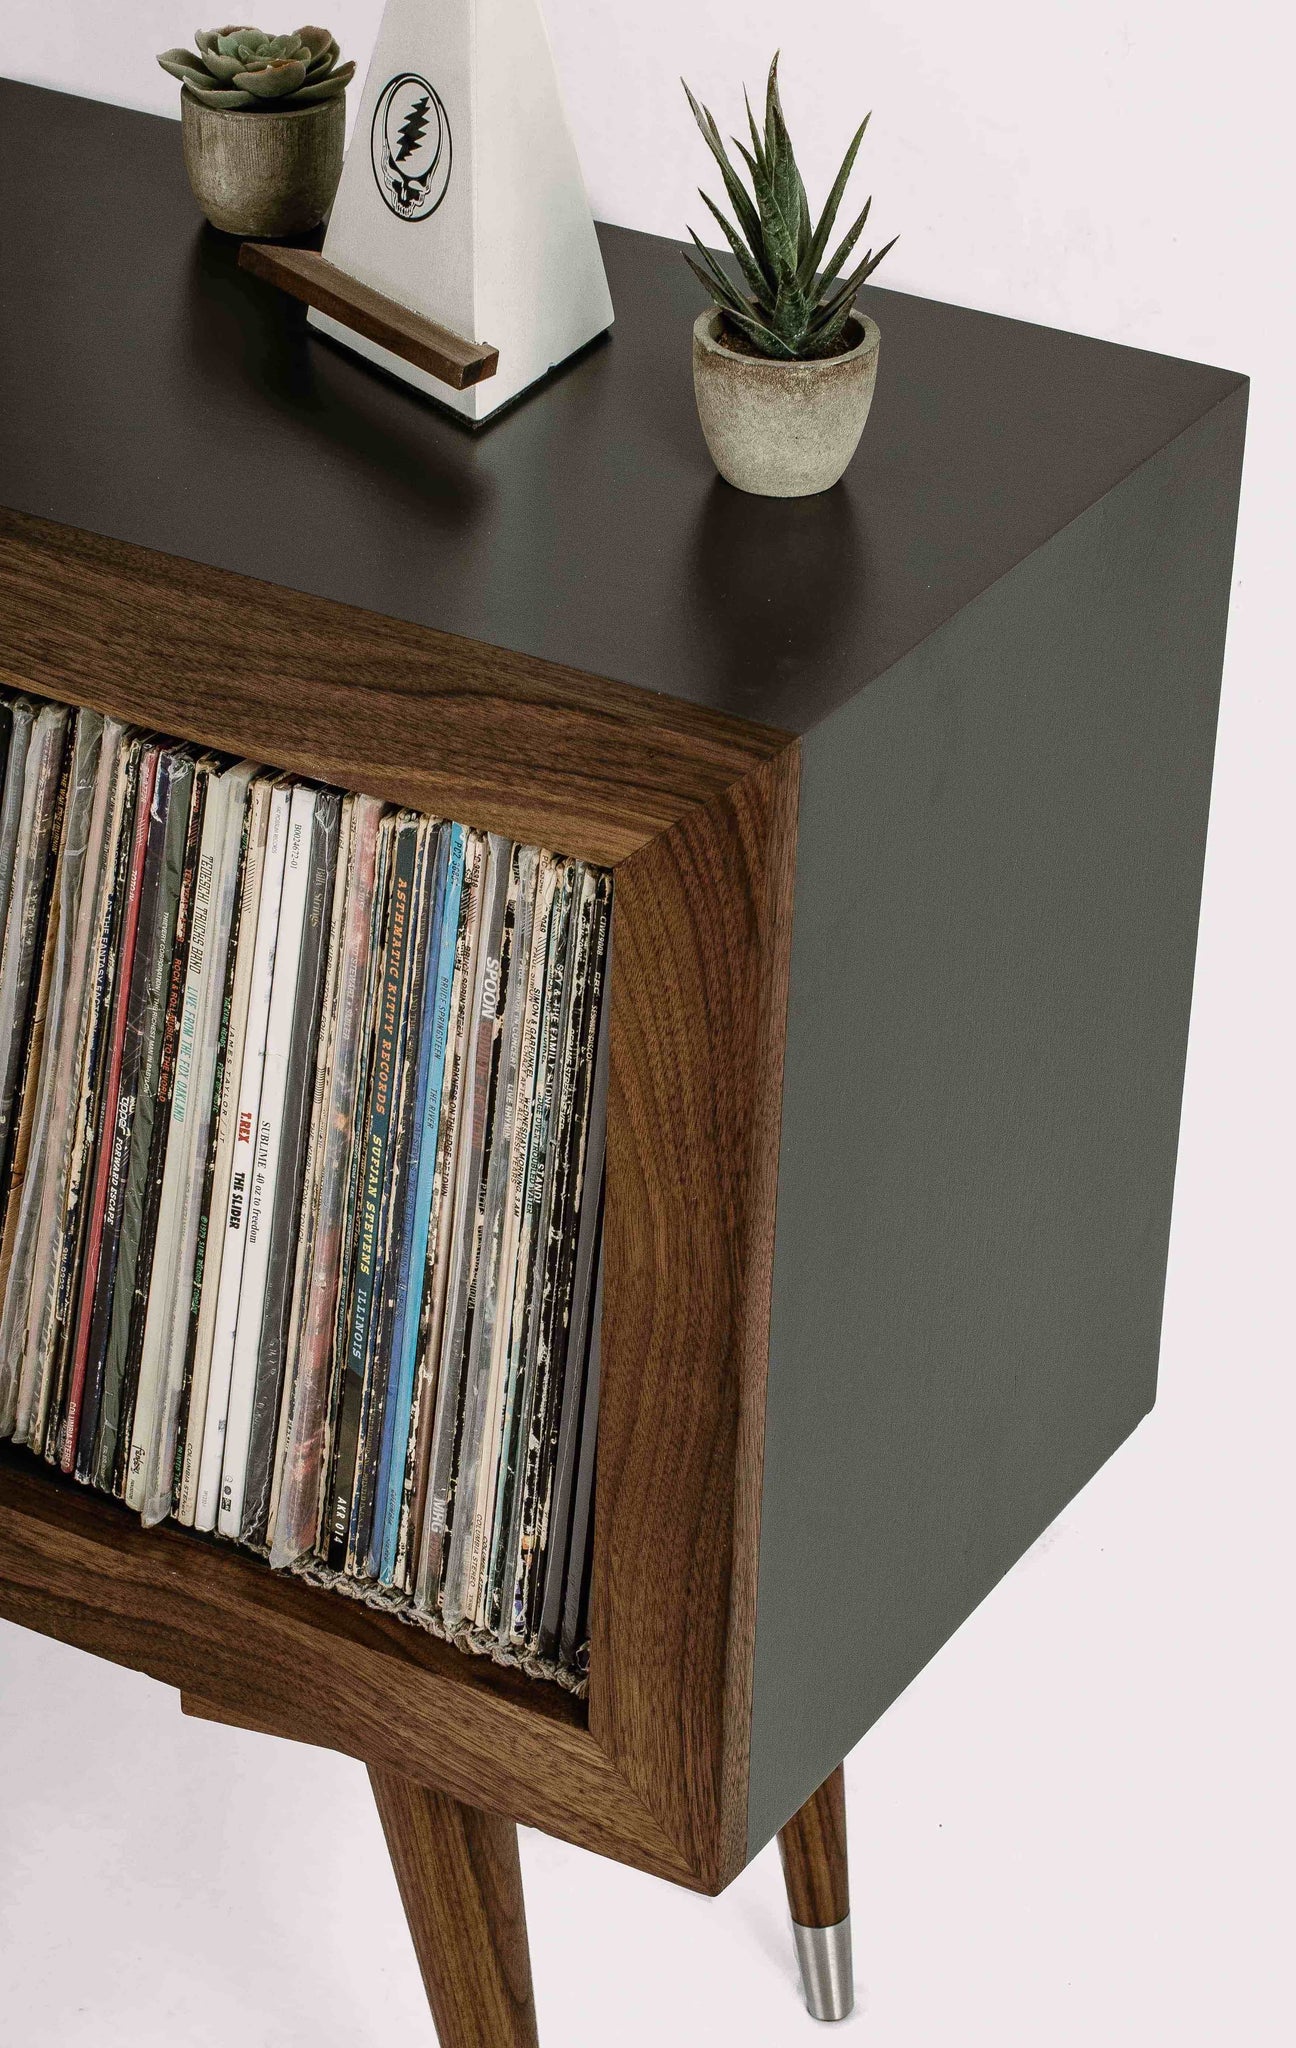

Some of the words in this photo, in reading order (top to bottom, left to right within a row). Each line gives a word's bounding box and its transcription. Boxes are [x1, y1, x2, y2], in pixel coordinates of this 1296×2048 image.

[59, 772, 68, 787] THE
[288, 823, 302, 869] B0024672-01
[452, 841, 462, 858] PC2
[183, 867, 191, 884] TEN
[196, 853, 213, 903] TEDESCHI
[313, 867, 325, 887] Billy
[102, 913, 110, 934] THE
[308, 890, 323, 928] Strings
[159, 911, 168, 942] THIEVERY
[191, 906, 207, 945] TRUCKS
[388, 878, 409, 978] ASTHMATIC
[96, 937, 107, 982] FANTASY
[154, 943, 165, 990] CORPORATION
[172, 958, 181, 982] ROCK
[188, 946, 203, 974] BAND
[168, 991, 177, 1011] ROLL
[185, 985, 198, 1006] LIVE
[438, 976, 448, 1003] BRUCE
[480, 956, 500, 1019] SPOON
[530, 987, 540, 1017] SIMON
[181, 1009, 196, 1036] FROM
[221, 996, 231, 1024] TALKING
[383, 982, 398, 1034] KITTY
[148, 1010, 157, 1040] RICHEST
[165, 1014, 175, 1041] MUSIC
[218, 1026, 227, 1047] HEADS
[433, 1005, 446, 1059] SPRINGSTEEN
[523, 1018, 532, 1042] STILL
[164, 1042, 172, 1054] TO
[179, 1039, 192, 1055] THE
[225, 1025, 235, 1064] JAMES
[521, 1044, 530, 1073] CRAZY
[526, 1027, 538, 1078] GARFUNKEL
[546, 1029, 557, 1067] FAMILY
[142, 1062, 151, 1093] BABYLON
[162, 1055, 170, 1071] THE
[177, 1058, 190, 1078] FOX
[374, 1039, 393, 1115] RECORDS
[158, 1072, 168, 1102] WORLD
[172, 1080, 188, 1122] OAKLAND
[220, 1070, 231, 1116] TAYLOR
[429, 1088, 437, 1103] THE
[505, 1083, 514, 1103] LIVE
[517, 1076, 526, 1104] AFTER
[426, 1105, 435, 1129] RIVER
[448, 1102, 455, 1114] ON
[516, 1106, 524, 1123] ALL
[218, 1130, 225, 1144] JT
[237, 1111, 252, 1144] T.REX
[446, 1115, 455, 1132] THE
[518, 1096, 531, 1151] WEDNESDAY
[532, 1116, 542, 1139] OVER
[256, 1120, 271, 1168] SUBLIME
[443, 1134, 453, 1158] EDGE
[513, 1125, 522, 1152] THESE
[110, 1136, 123, 1185] FORWARD
[366, 1134, 383, 1196] SUFJAN
[509, 1154, 519, 1183] YEARS
[528, 1141, 539, 1185] TROUBLED
[232, 1171, 245, 1192] THE
[254, 1185, 261, 1195] oz
[255, 1172, 265, 1184] 40
[440, 1172, 449, 1196] TOWN
[532, 1162, 544, 1203] STAND!
[106, 1186, 117, 1225] ESCAPE
[228, 1193, 243, 1229] SLIDER
[253, 1197, 261, 1206] to
[512, 1202, 520, 1217] AM
[525, 1186, 535, 1214] WATER
[248, 1207, 261, 1244] freedom
[358, 1201, 377, 1274] STEVENS
[350, 1288, 368, 1359] ILLINOIS
[65, 1401, 76, 1437] COLUMBIA
[62, 1438, 72, 1467] STEREO
[182, 1442, 193, 1483] COLUMBIA
[335, 1496, 347, 1517] AKR
[429, 1498, 445, 1533] MRG
[333, 1522, 344, 1543] 014
[472, 1513, 482, 1554] COLUMBIA
[468, 1555, 478, 1587] STEREO
